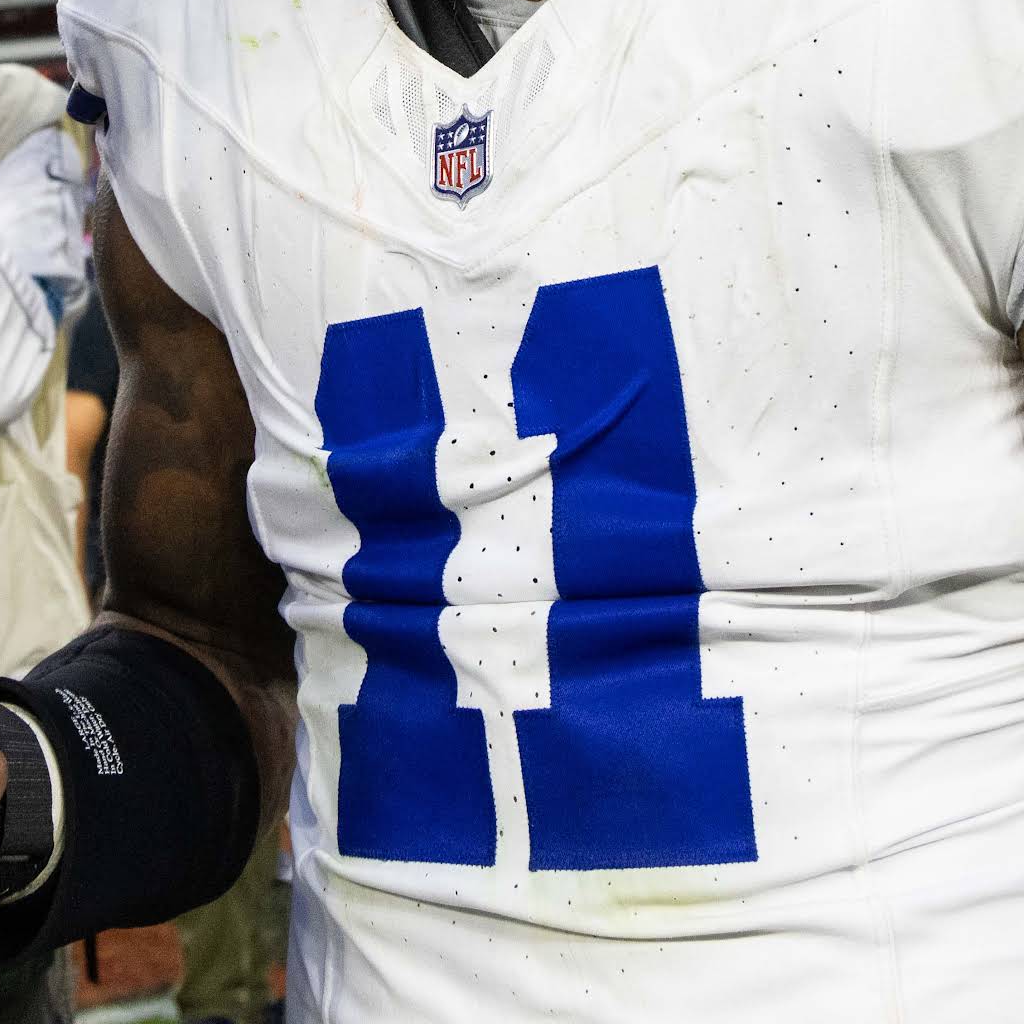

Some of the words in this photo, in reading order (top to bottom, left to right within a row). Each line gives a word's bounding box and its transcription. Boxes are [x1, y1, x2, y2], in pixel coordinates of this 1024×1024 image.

[438, 148, 481, 189] NFL
[314, 264, 759, 872] 11
[94, 712, 107, 728] Dry
[104, 729, 115, 743] Air
[93, 748, 103, 775] Made
[98, 749, 110, 775] Hand
[101, 740, 113, 763] Cold
[110, 764, 117, 775] In
